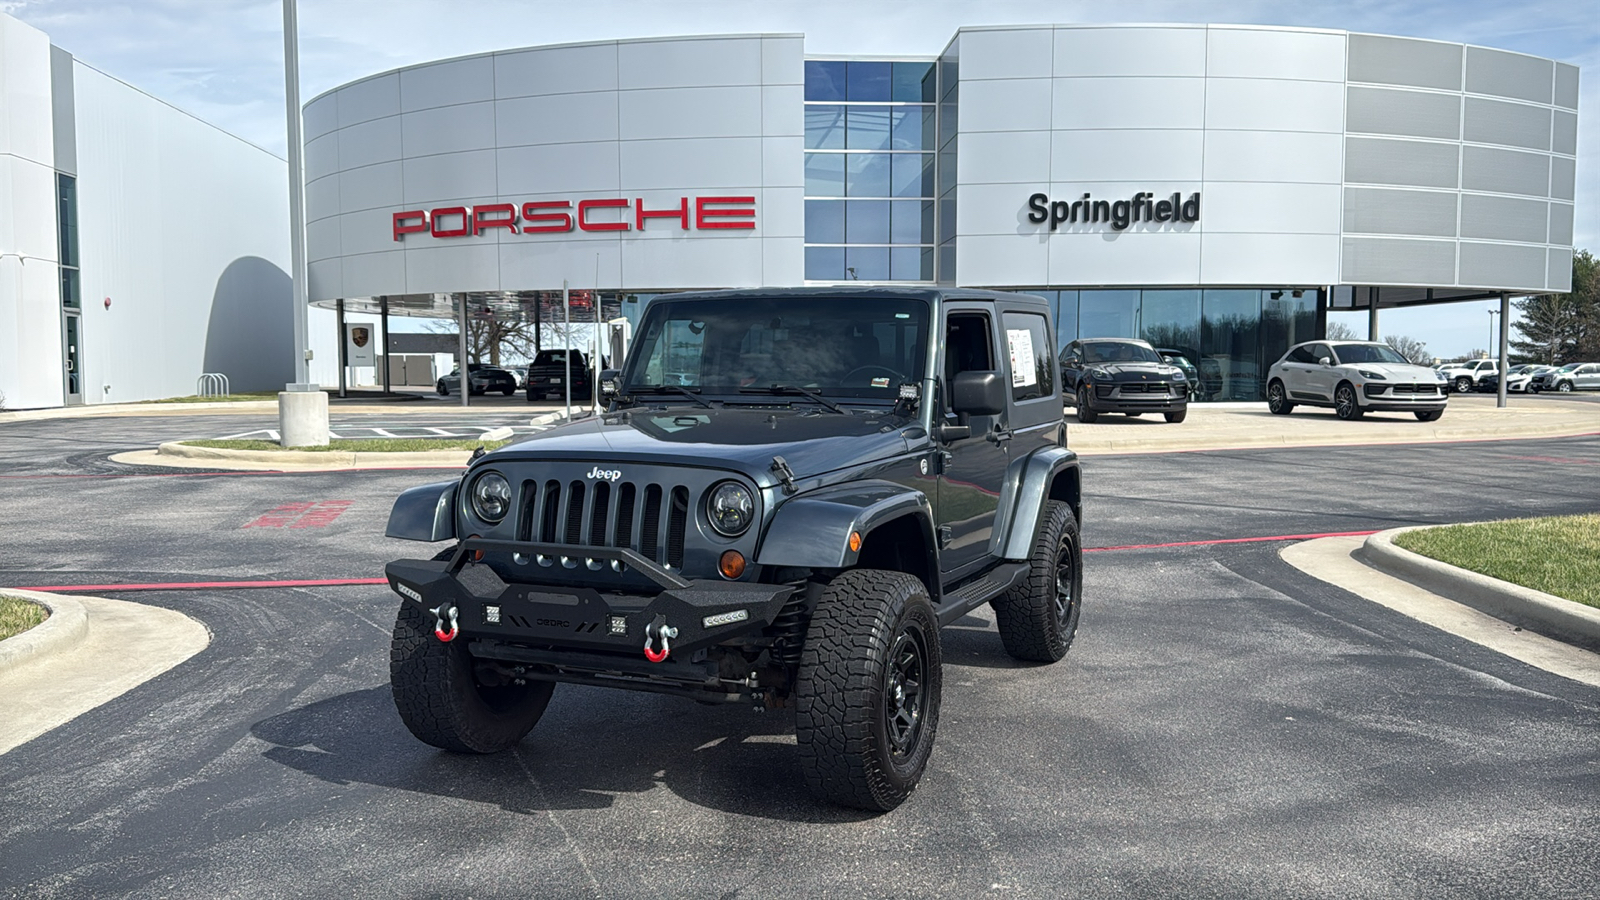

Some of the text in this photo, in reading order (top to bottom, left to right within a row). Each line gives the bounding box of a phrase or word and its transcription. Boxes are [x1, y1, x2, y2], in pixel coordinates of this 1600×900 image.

[393, 196, 756, 242] PORSCHE
[1028, 192, 1201, 231] Springfield
[586, 466, 622, 482] Jeep
